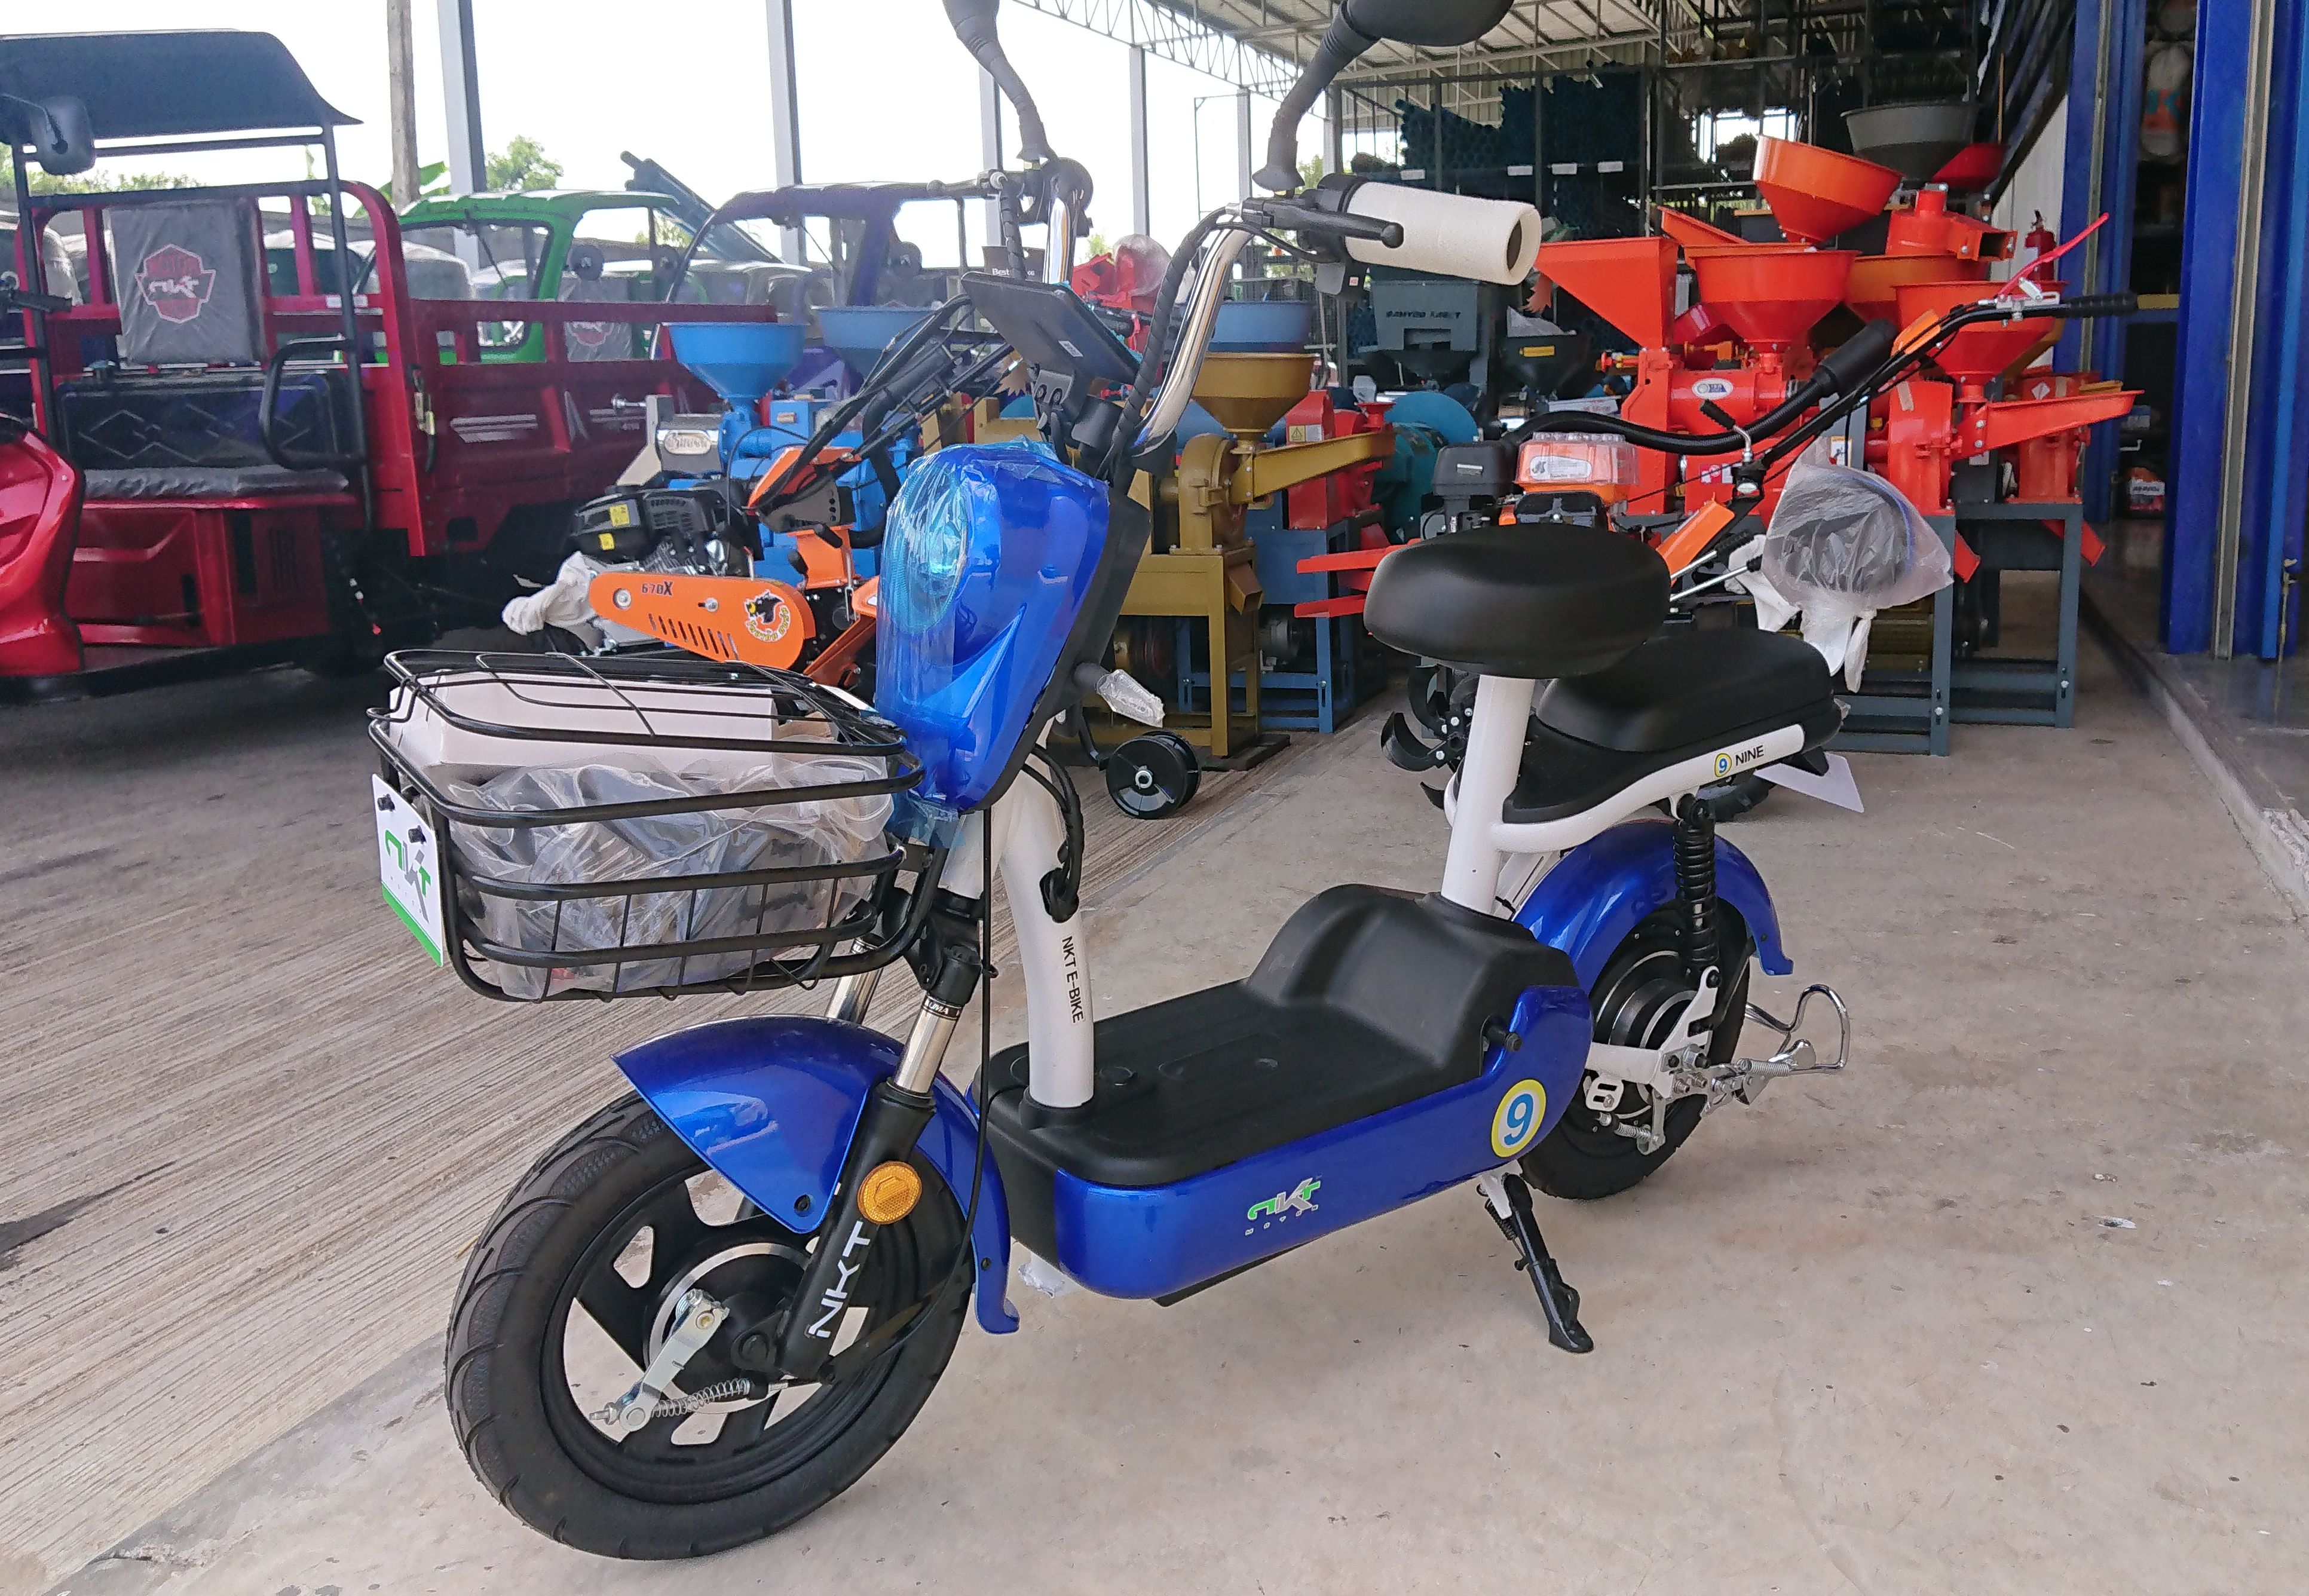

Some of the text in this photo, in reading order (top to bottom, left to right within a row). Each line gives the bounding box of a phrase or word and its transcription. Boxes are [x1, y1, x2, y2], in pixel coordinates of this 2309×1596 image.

[642, 580, 673, 596] 670X
[1735, 745, 1764, 766] NINE
[1062, 936, 1084, 1024] NKT E-BIKE
[1503, 1093, 1534, 1145] 9
[808, 1220, 871, 1338] NKT
